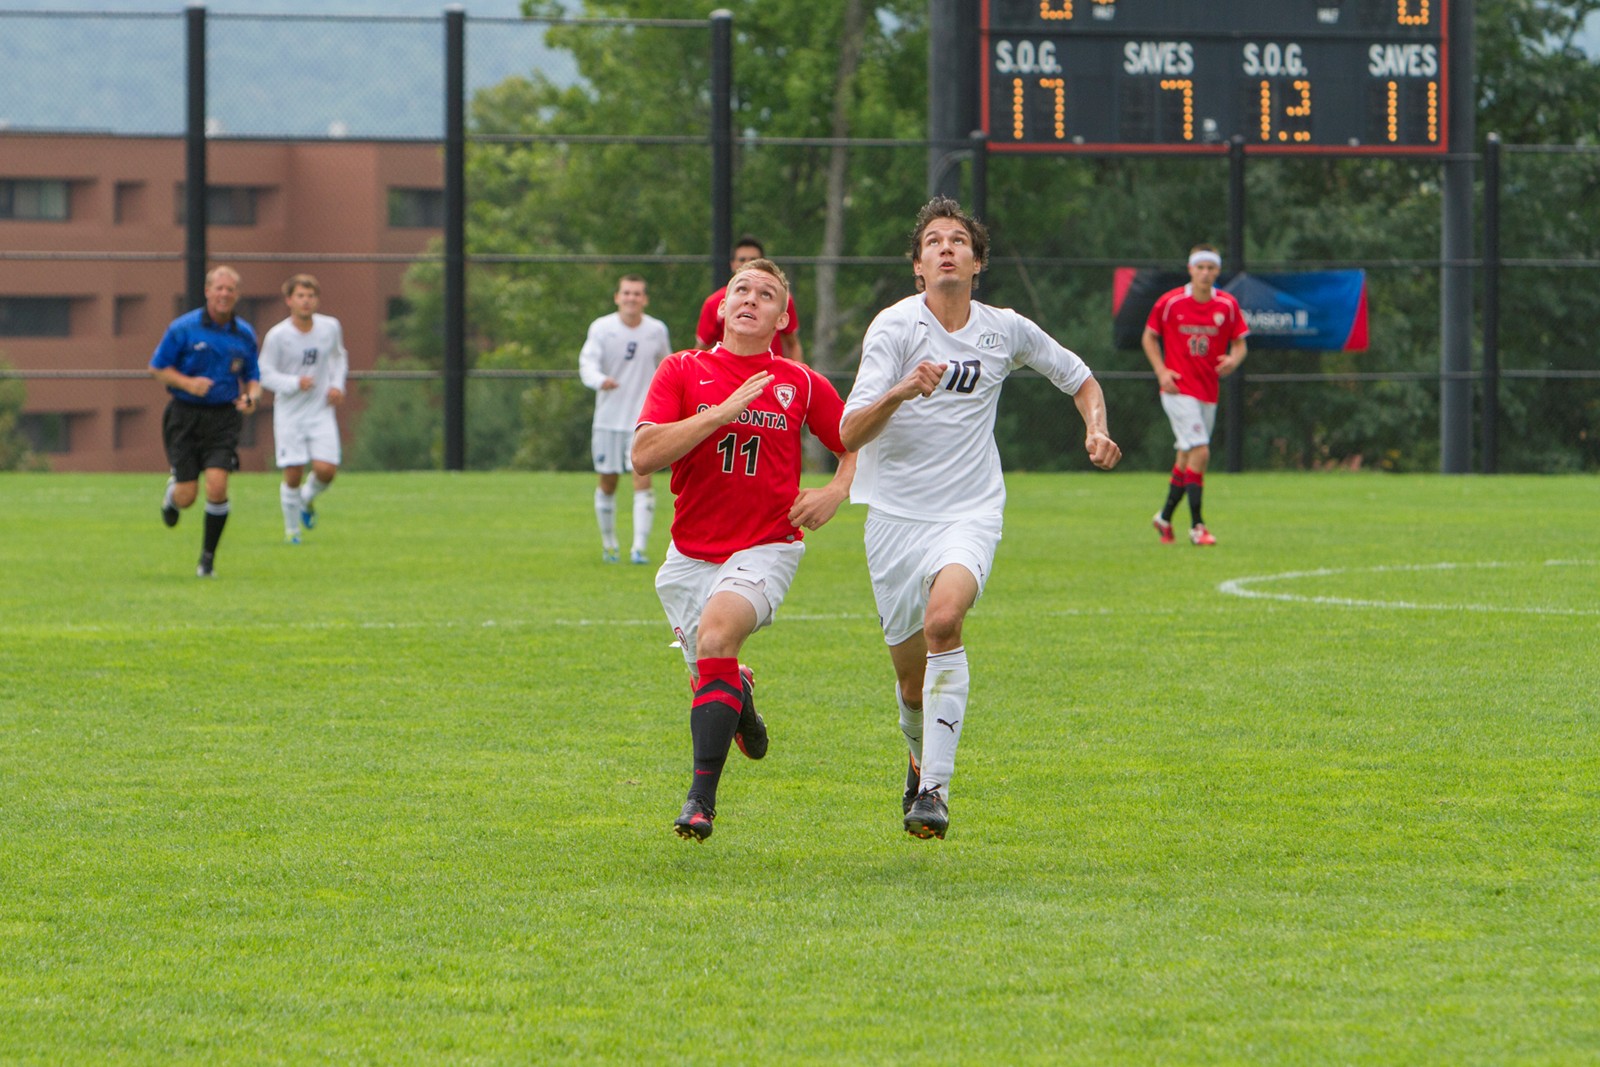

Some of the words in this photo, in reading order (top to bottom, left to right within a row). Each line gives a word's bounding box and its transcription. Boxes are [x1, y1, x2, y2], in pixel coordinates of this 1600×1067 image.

[996, 40, 1062, 74] S.O.G.
[1123, 41, 1195, 76] SAVES
[1242, 43, 1309, 76] S.O.G.
[1368, 44, 1438, 77] SAVES
[1013, 77, 1066, 141] 17
[1160, 79, 1194, 141] 7
[1388, 81, 1438, 142] 11
[302, 347, 318, 366] 19
[624, 341, 638, 361] 9
[945, 359, 982, 394] 10
[716, 432, 761, 476] 11
